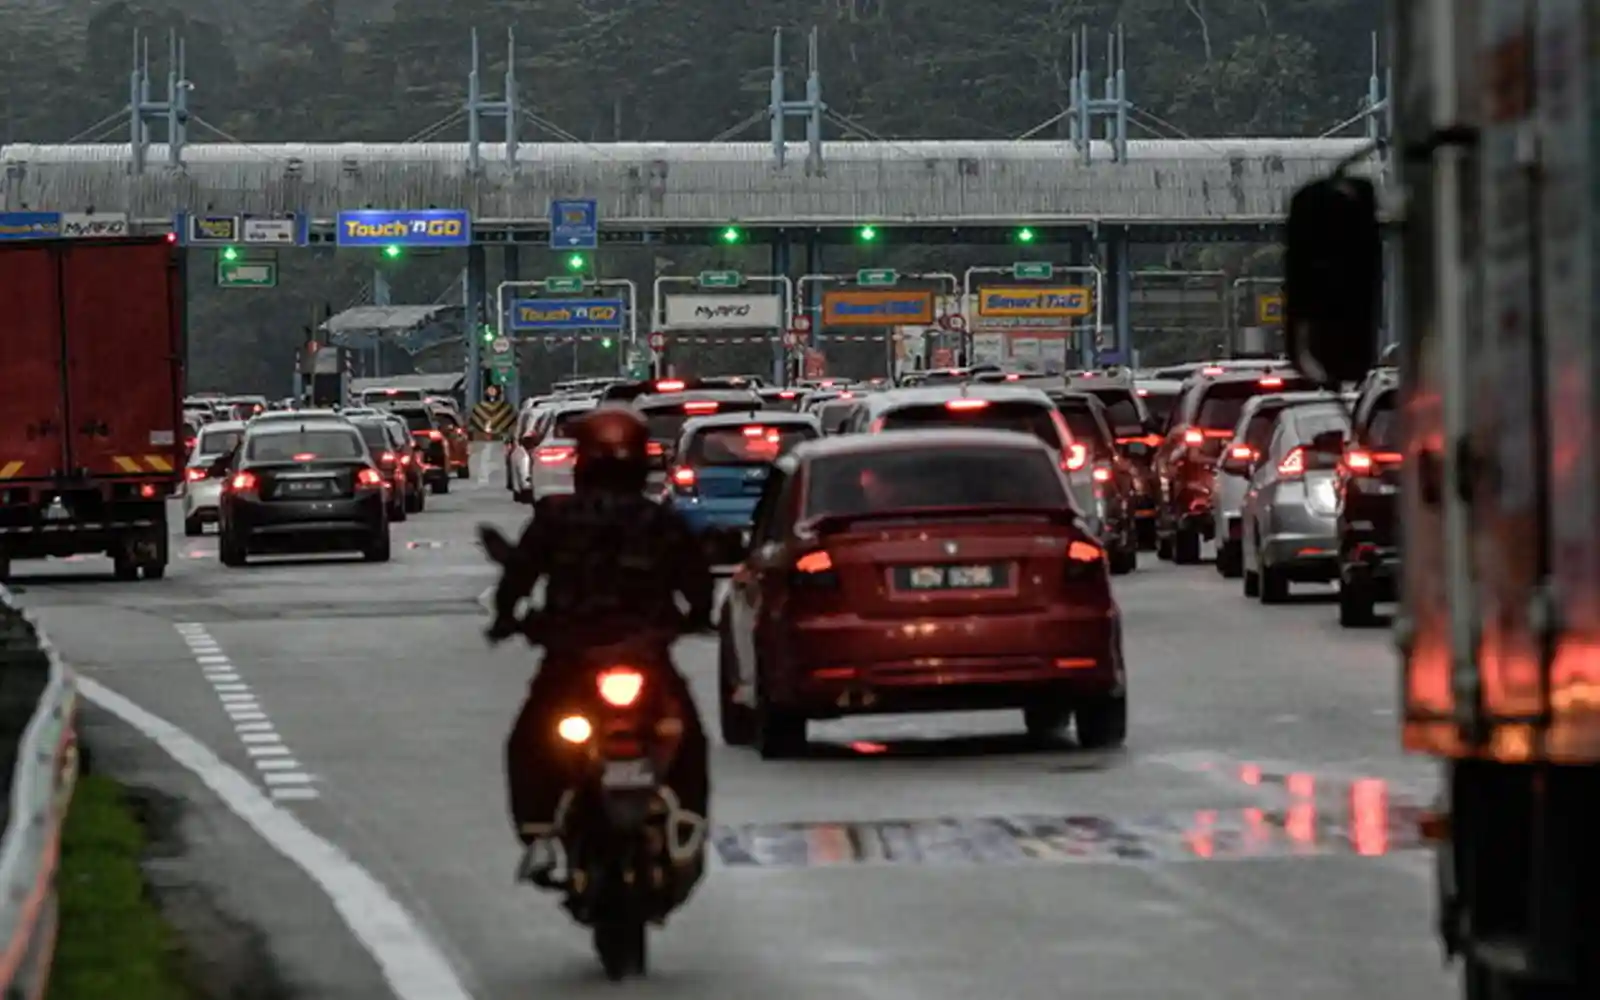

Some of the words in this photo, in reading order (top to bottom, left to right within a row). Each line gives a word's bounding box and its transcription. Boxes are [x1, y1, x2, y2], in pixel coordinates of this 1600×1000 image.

[345, 220, 408, 237] Touch
[428, 219, 461, 236] GO
[520, 307, 572, 322] Touch
